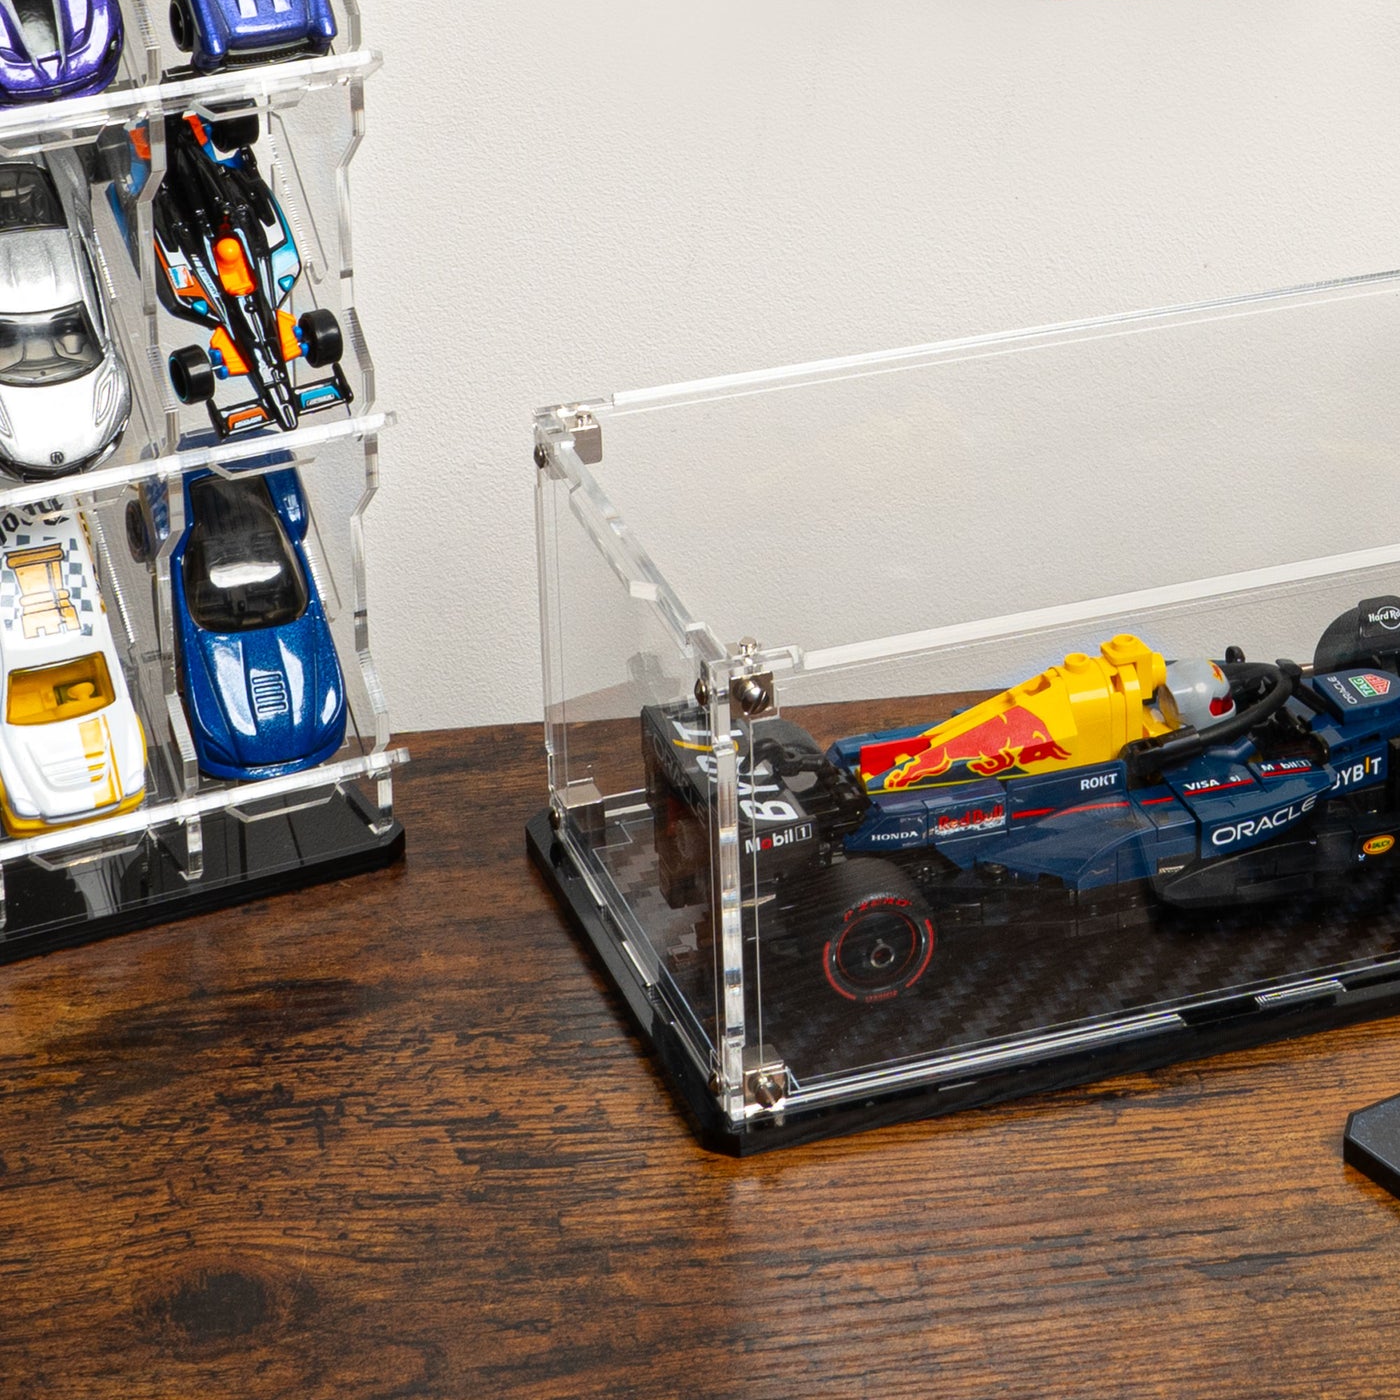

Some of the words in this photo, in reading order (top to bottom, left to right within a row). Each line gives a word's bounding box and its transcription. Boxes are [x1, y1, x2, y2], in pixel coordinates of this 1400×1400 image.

[1368, 611, 1389, 623] Hard
[1327, 675, 1358, 704] ORACLE
[1353, 678, 1373, 696] TAG
[1080, 773, 1118, 791] ROKT
[1183, 778, 1220, 791] VISA
[1211, 795, 1318, 846] ORACLE
[744, 830, 794, 855] Mobil
[871, 830, 919, 842] HONDA
